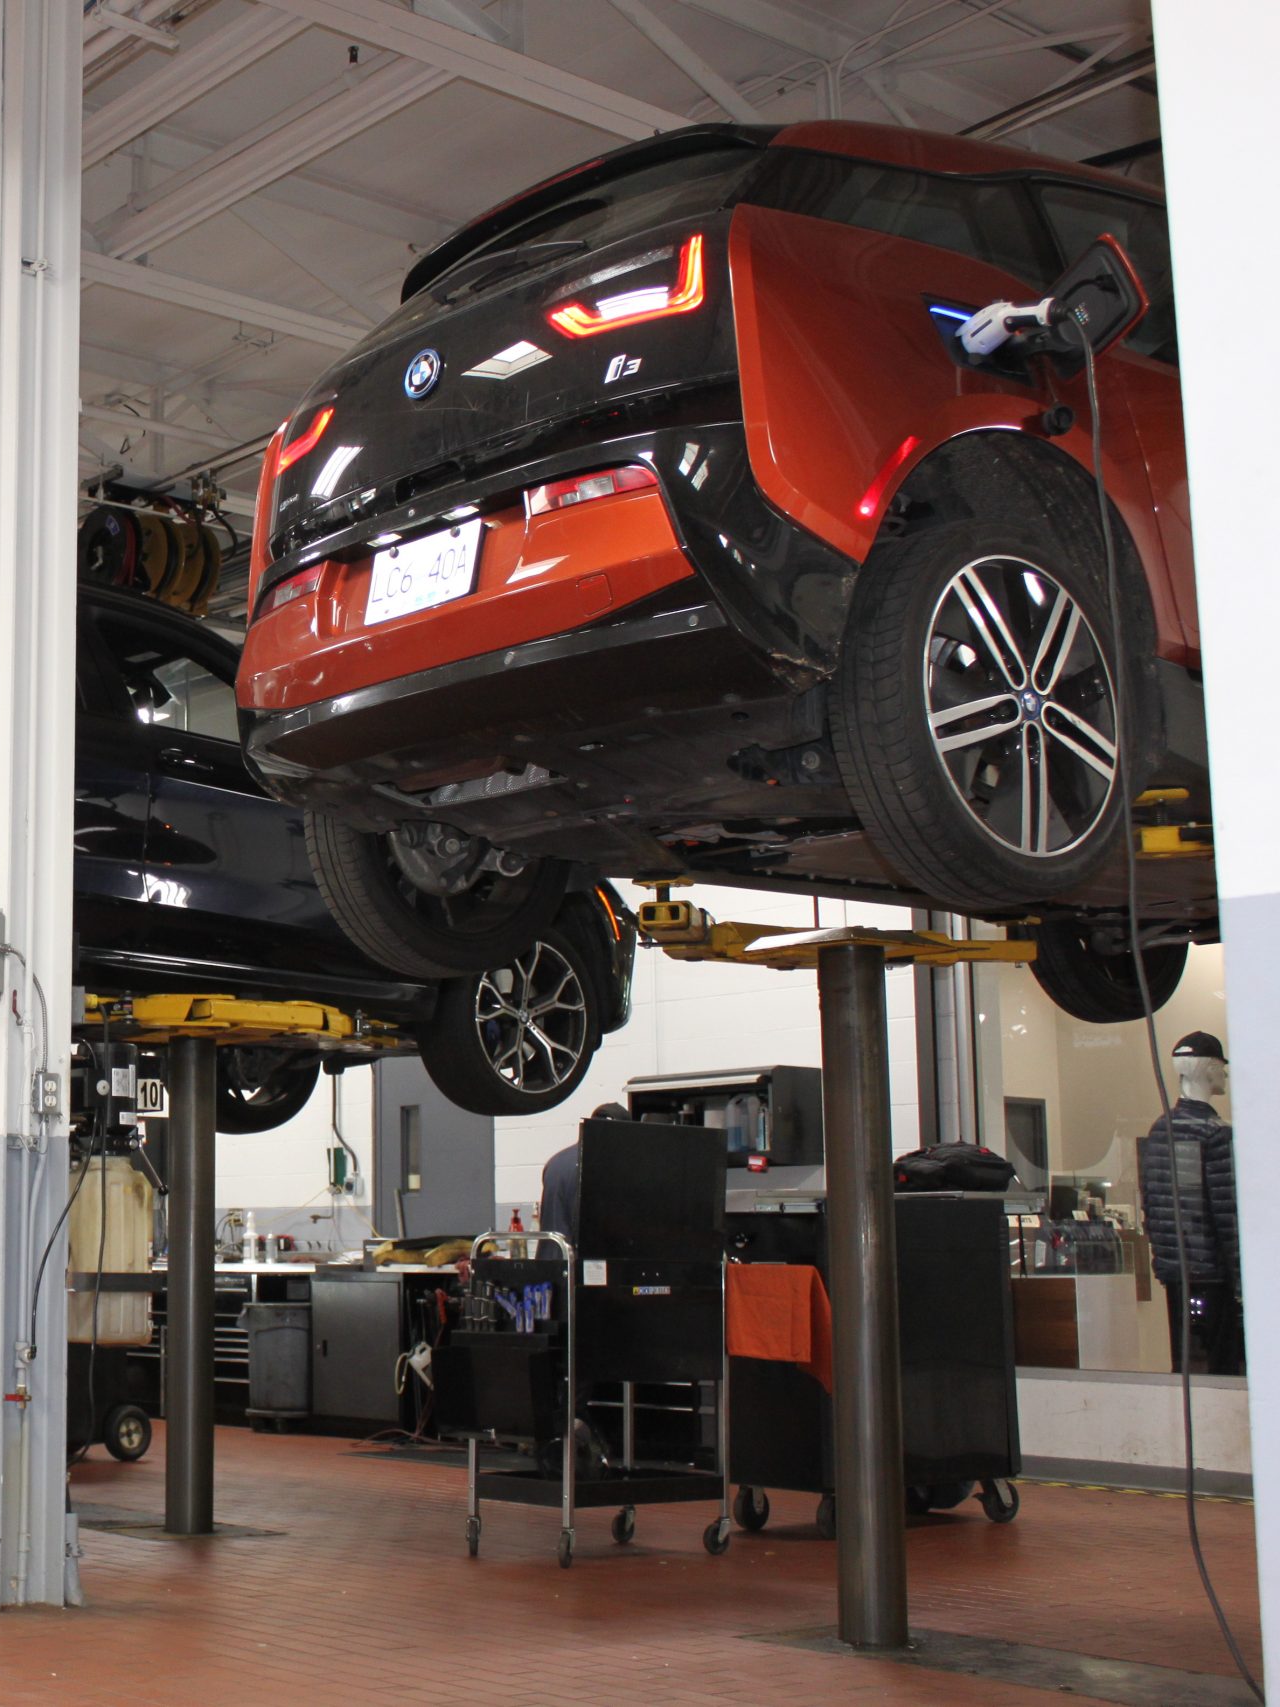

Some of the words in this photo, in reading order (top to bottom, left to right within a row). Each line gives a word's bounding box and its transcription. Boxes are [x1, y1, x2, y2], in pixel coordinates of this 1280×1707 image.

[604, 354, 642, 384] i3
[371, 562, 413, 603] LC6
[428, 544, 467, 583] 40A
[140, 1081, 158, 1108] 10
